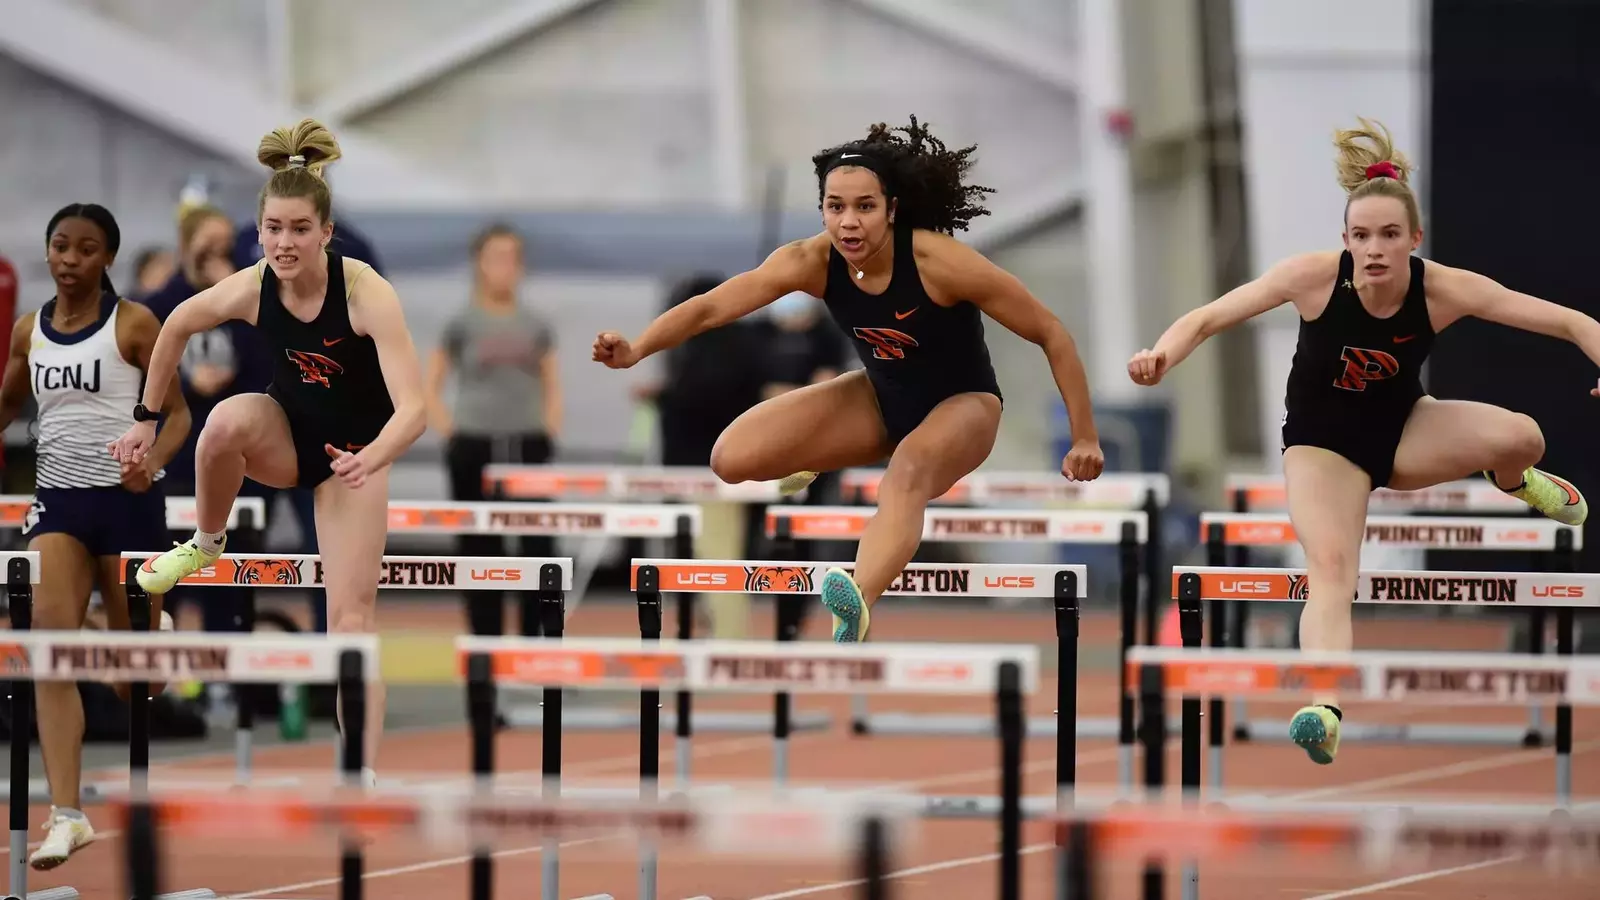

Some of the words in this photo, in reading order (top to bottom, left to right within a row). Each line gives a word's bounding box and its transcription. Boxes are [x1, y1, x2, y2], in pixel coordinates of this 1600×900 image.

[1333, 345, 1399, 391] P
[35, 359, 101, 395] TCNJ
[1366, 525, 1484, 544] PRINCETON
[471, 569, 522, 582] UCS
[676, 573, 728, 585] UCS
[984, 576, 1036, 588] UCS
[1219, 581, 1272, 594] UCS
[1370, 577, 1517, 603] PRINCETON
[1532, 586, 1584, 598] UCS
